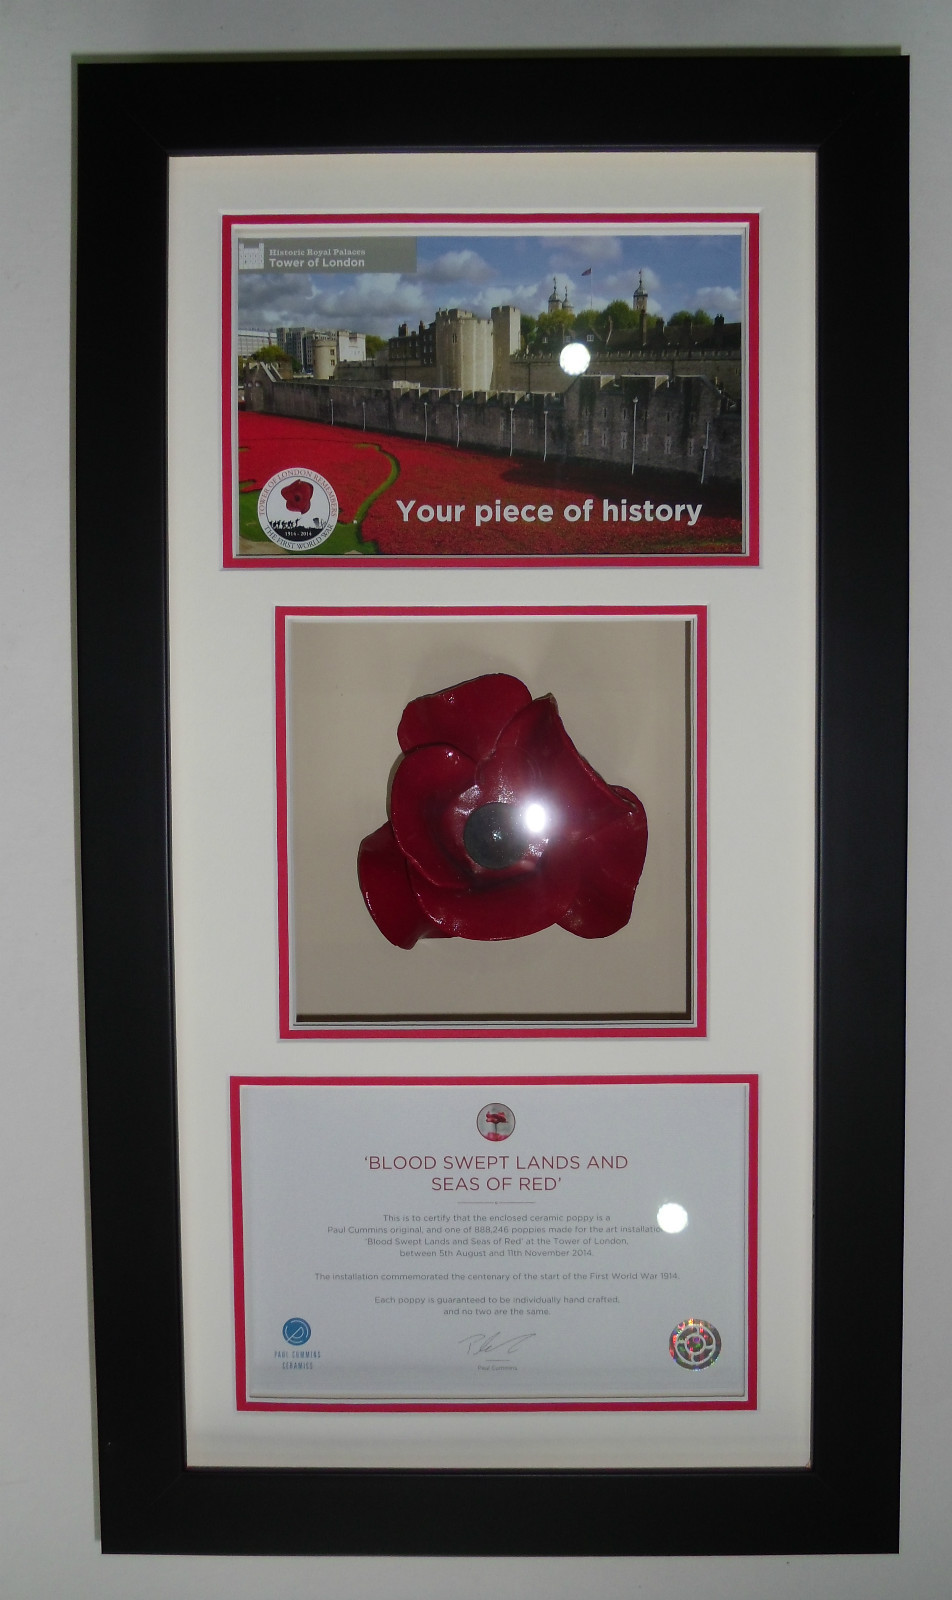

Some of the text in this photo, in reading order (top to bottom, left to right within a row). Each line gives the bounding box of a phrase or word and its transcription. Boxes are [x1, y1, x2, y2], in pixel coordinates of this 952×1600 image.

[306, 248, 331, 257] Royal
[333, 248, 366, 256] Palaces
[269, 257, 365, 268] Tower of London
[259, 470, 337, 517] TOWER OF LONDON REMEMBERS
[395, 498, 703, 527] Your piece of history
[265, 524, 334, 550] THE FIRST WORLD WAR
[443, 1155, 510, 1170] SWEPT
[516, 1155, 580, 1170] LANDS
[586, 1155, 628, 1169] AND
[431, 1177, 480, 1191] SEAS
[486, 1177, 513, 1191] OF
[383, 1214, 401, 1222] This
[402, 1214, 410, 1222] is
[423, 1214, 451, 1224] certify
[472, 1214, 487, 1222] the
[489, 1214, 528, 1222] enclosed
[566, 1215, 594, 1224] poppy
[596, 1214, 603, 1222] is
[327, 1226, 346, 1234] Paul
[347, 1226, 388, 1234] Cummins
[462, 1226, 472, 1234] of
[474, 1226, 509, 1234] 888,246
[511, 1227, 546, 1235] poppies
[620, 1225, 664, 1233] installatio
[394, 1238, 422, 1247] Swept
[470, 1237, 491, 1245] Seas
[492, 1237, 502, 1245] of
[553, 1237, 580, 1245] Tower
[439, 1249, 454, 1257] 5th
[455, 1250, 487, 1258] August
[507, 1249, 523, 1257] 11th
[314, 1272, 331, 1281] The
[332, 1273, 379, 1281] installation
[380, 1273, 449, 1281] commemorated
[451, 1273, 466, 1281] the
[467, 1274, 511, 1282] centenary
[512, 1272, 522, 1280] of
[562, 1272, 572, 1280] of
[589, 1272, 609, 1280] First
[611, 1272, 638, 1280] World
[640, 1272, 658, 1280] War
[374, 1296, 396, 1304] Each
[398, 1297, 426, 1306] poppy
[427, 1296, 435, 1304] is
[436, 1296, 486, 1306] guaranteed
[488, 1296, 498, 1304] to
[499, 1296, 511, 1304] be
[512, 1296, 561, 1305] individually
[563, 1296, 585, 1304] hand
